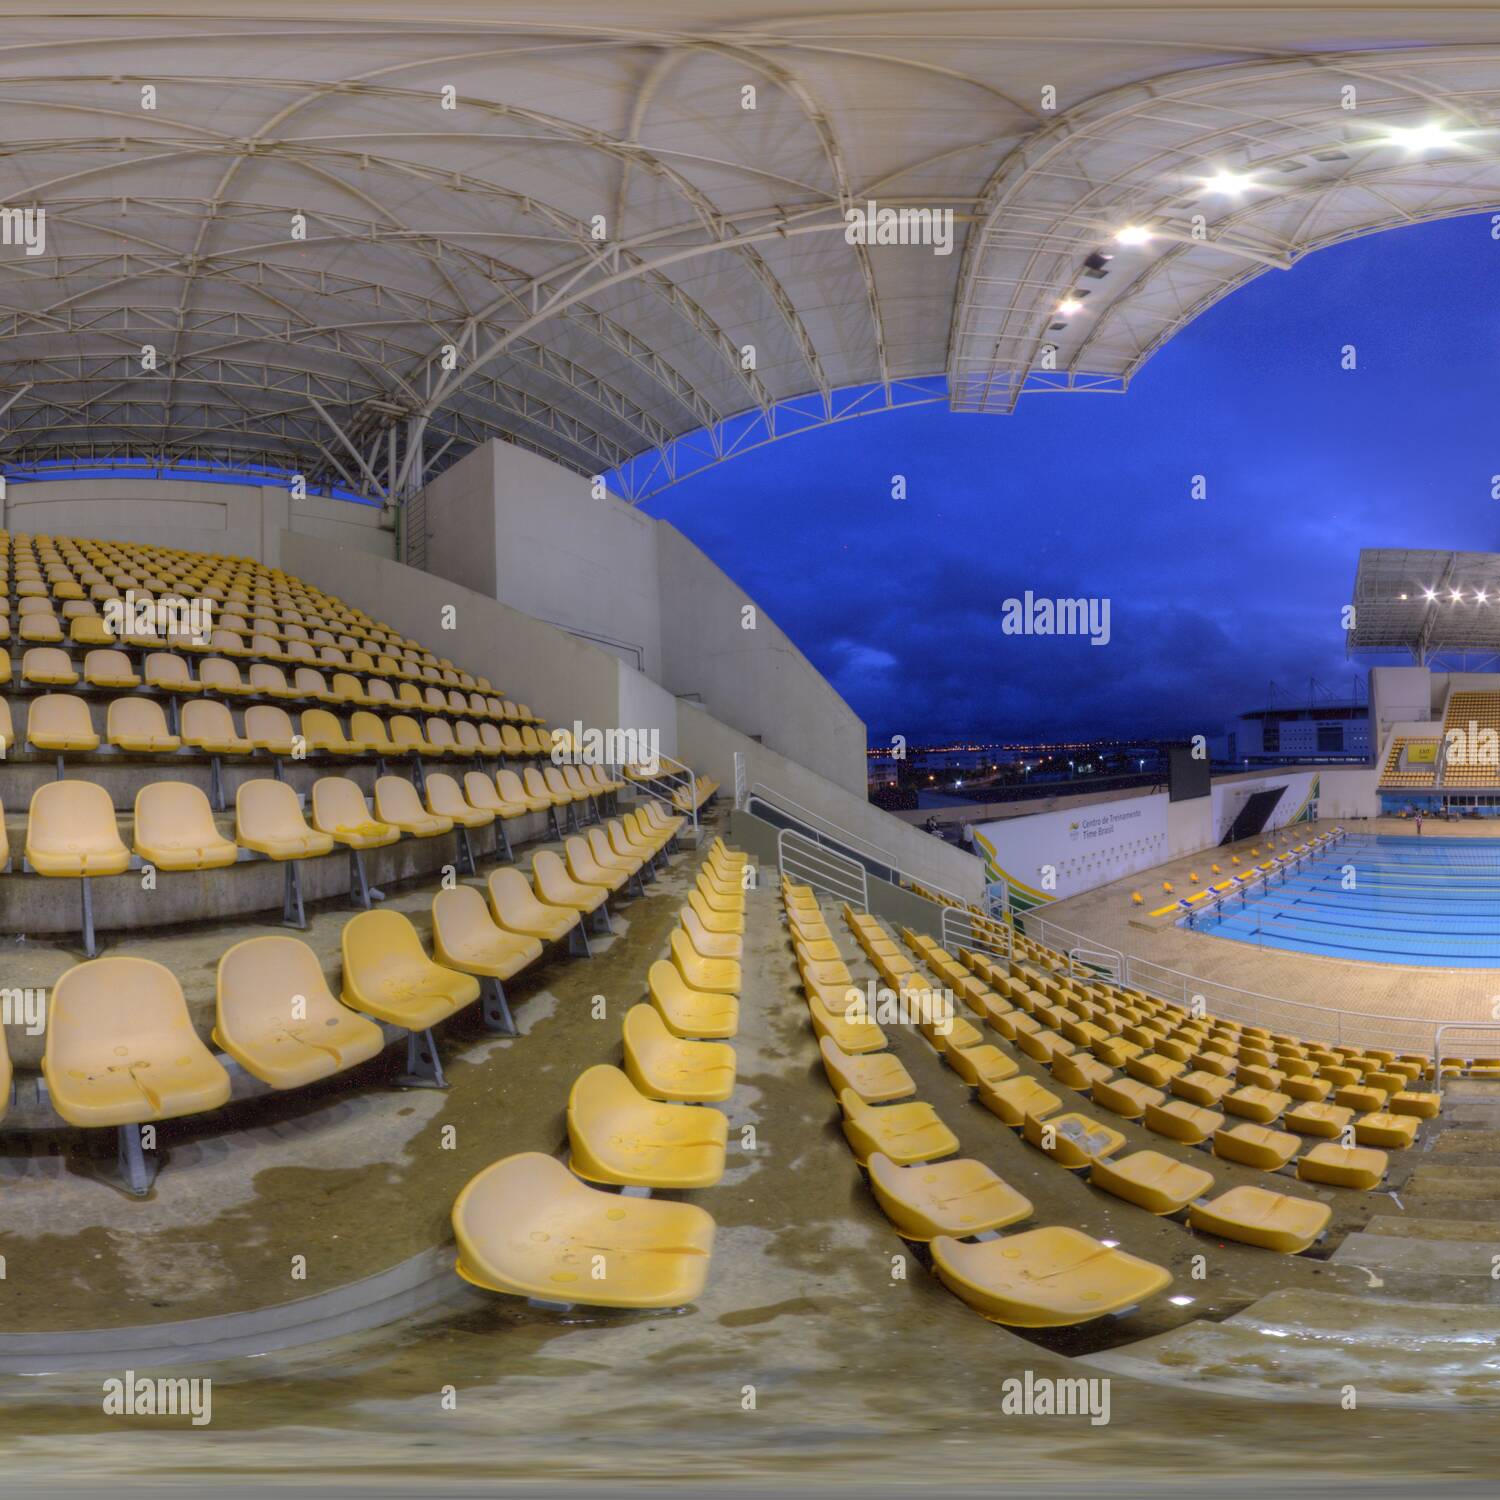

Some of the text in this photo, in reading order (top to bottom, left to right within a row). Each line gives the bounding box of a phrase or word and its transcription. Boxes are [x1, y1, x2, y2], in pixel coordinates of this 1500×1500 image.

[1082, 817, 1101, 829] Centro
[1102, 815, 1109, 825] de
[1083, 829, 1097, 840] Time
[1098, 825, 1114, 836] Brasil
